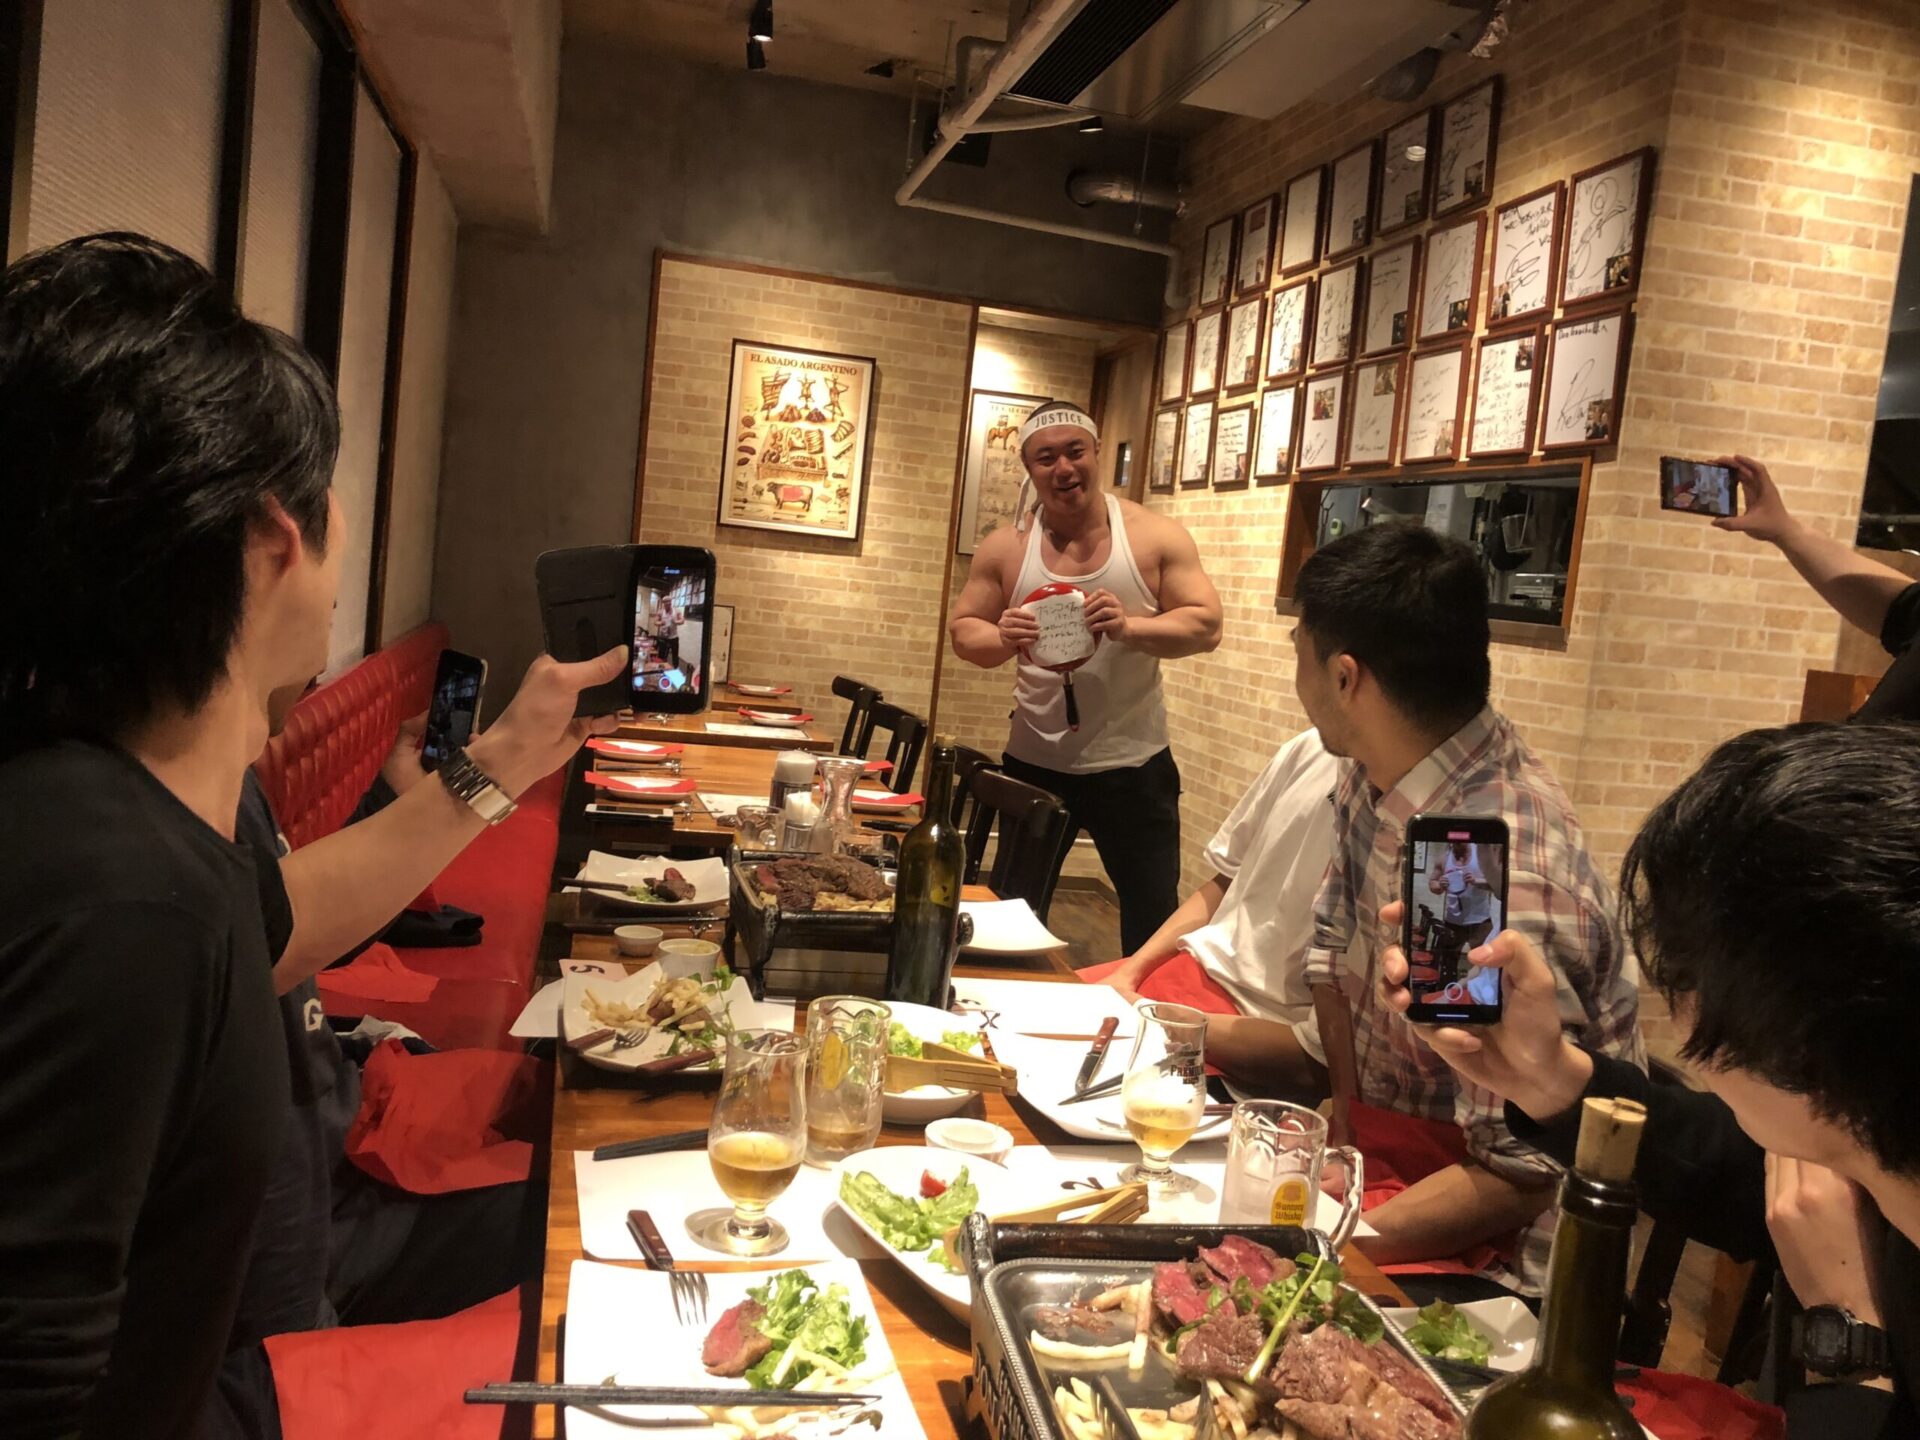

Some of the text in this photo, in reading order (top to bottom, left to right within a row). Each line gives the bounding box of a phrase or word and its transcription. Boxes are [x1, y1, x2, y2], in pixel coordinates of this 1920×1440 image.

[750, 353, 857, 376] EL ASADO ARGENTINO
[1035, 412, 1083, 428] JUSTICE
